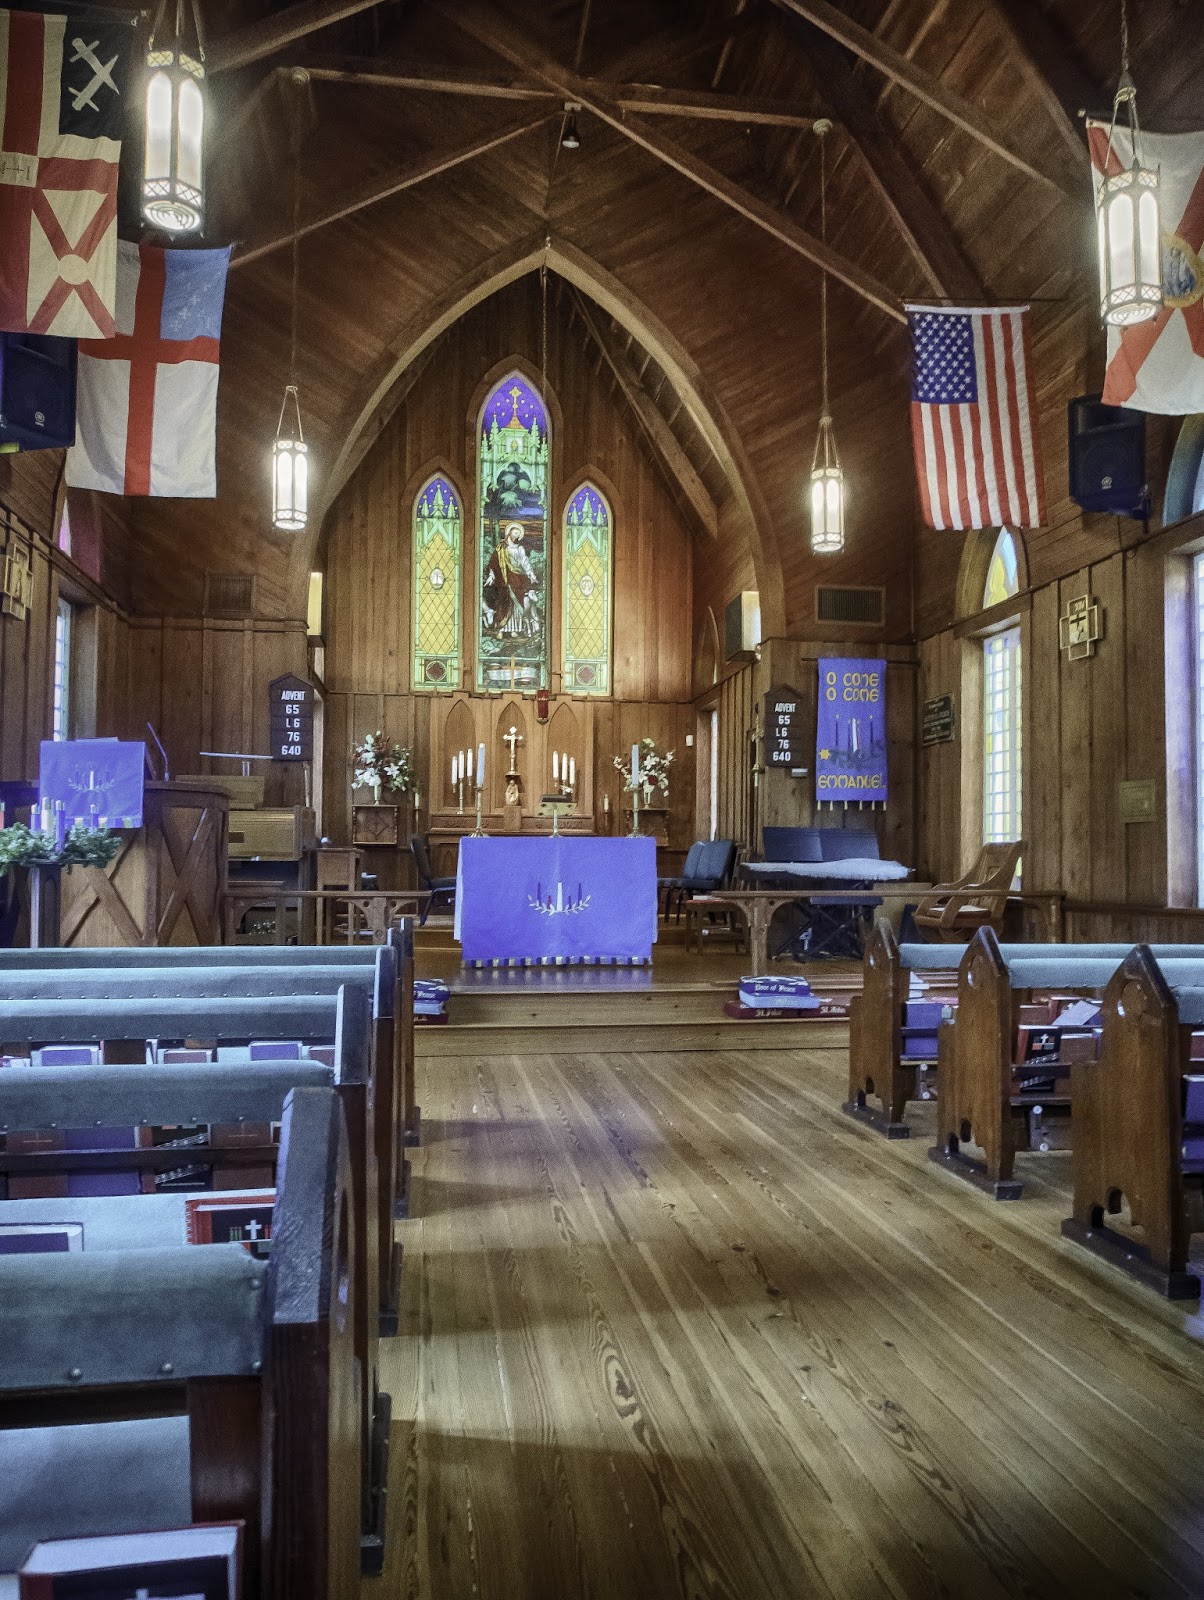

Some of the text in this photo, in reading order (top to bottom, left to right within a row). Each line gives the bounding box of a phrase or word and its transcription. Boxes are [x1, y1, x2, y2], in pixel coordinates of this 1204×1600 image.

[826, 671, 837, 685] O
[281, 691, 305, 700] ADVENT
[826, 687, 837, 701] O
[285, 704, 300, 714] 65
[775, 703, 796, 712] ADVENT
[778, 715, 791, 725] 65
[287, 732, 300, 742] 76
[778, 739, 790, 749] 76
[281, 745, 301, 755] 640
[772, 751, 791, 761] 640
